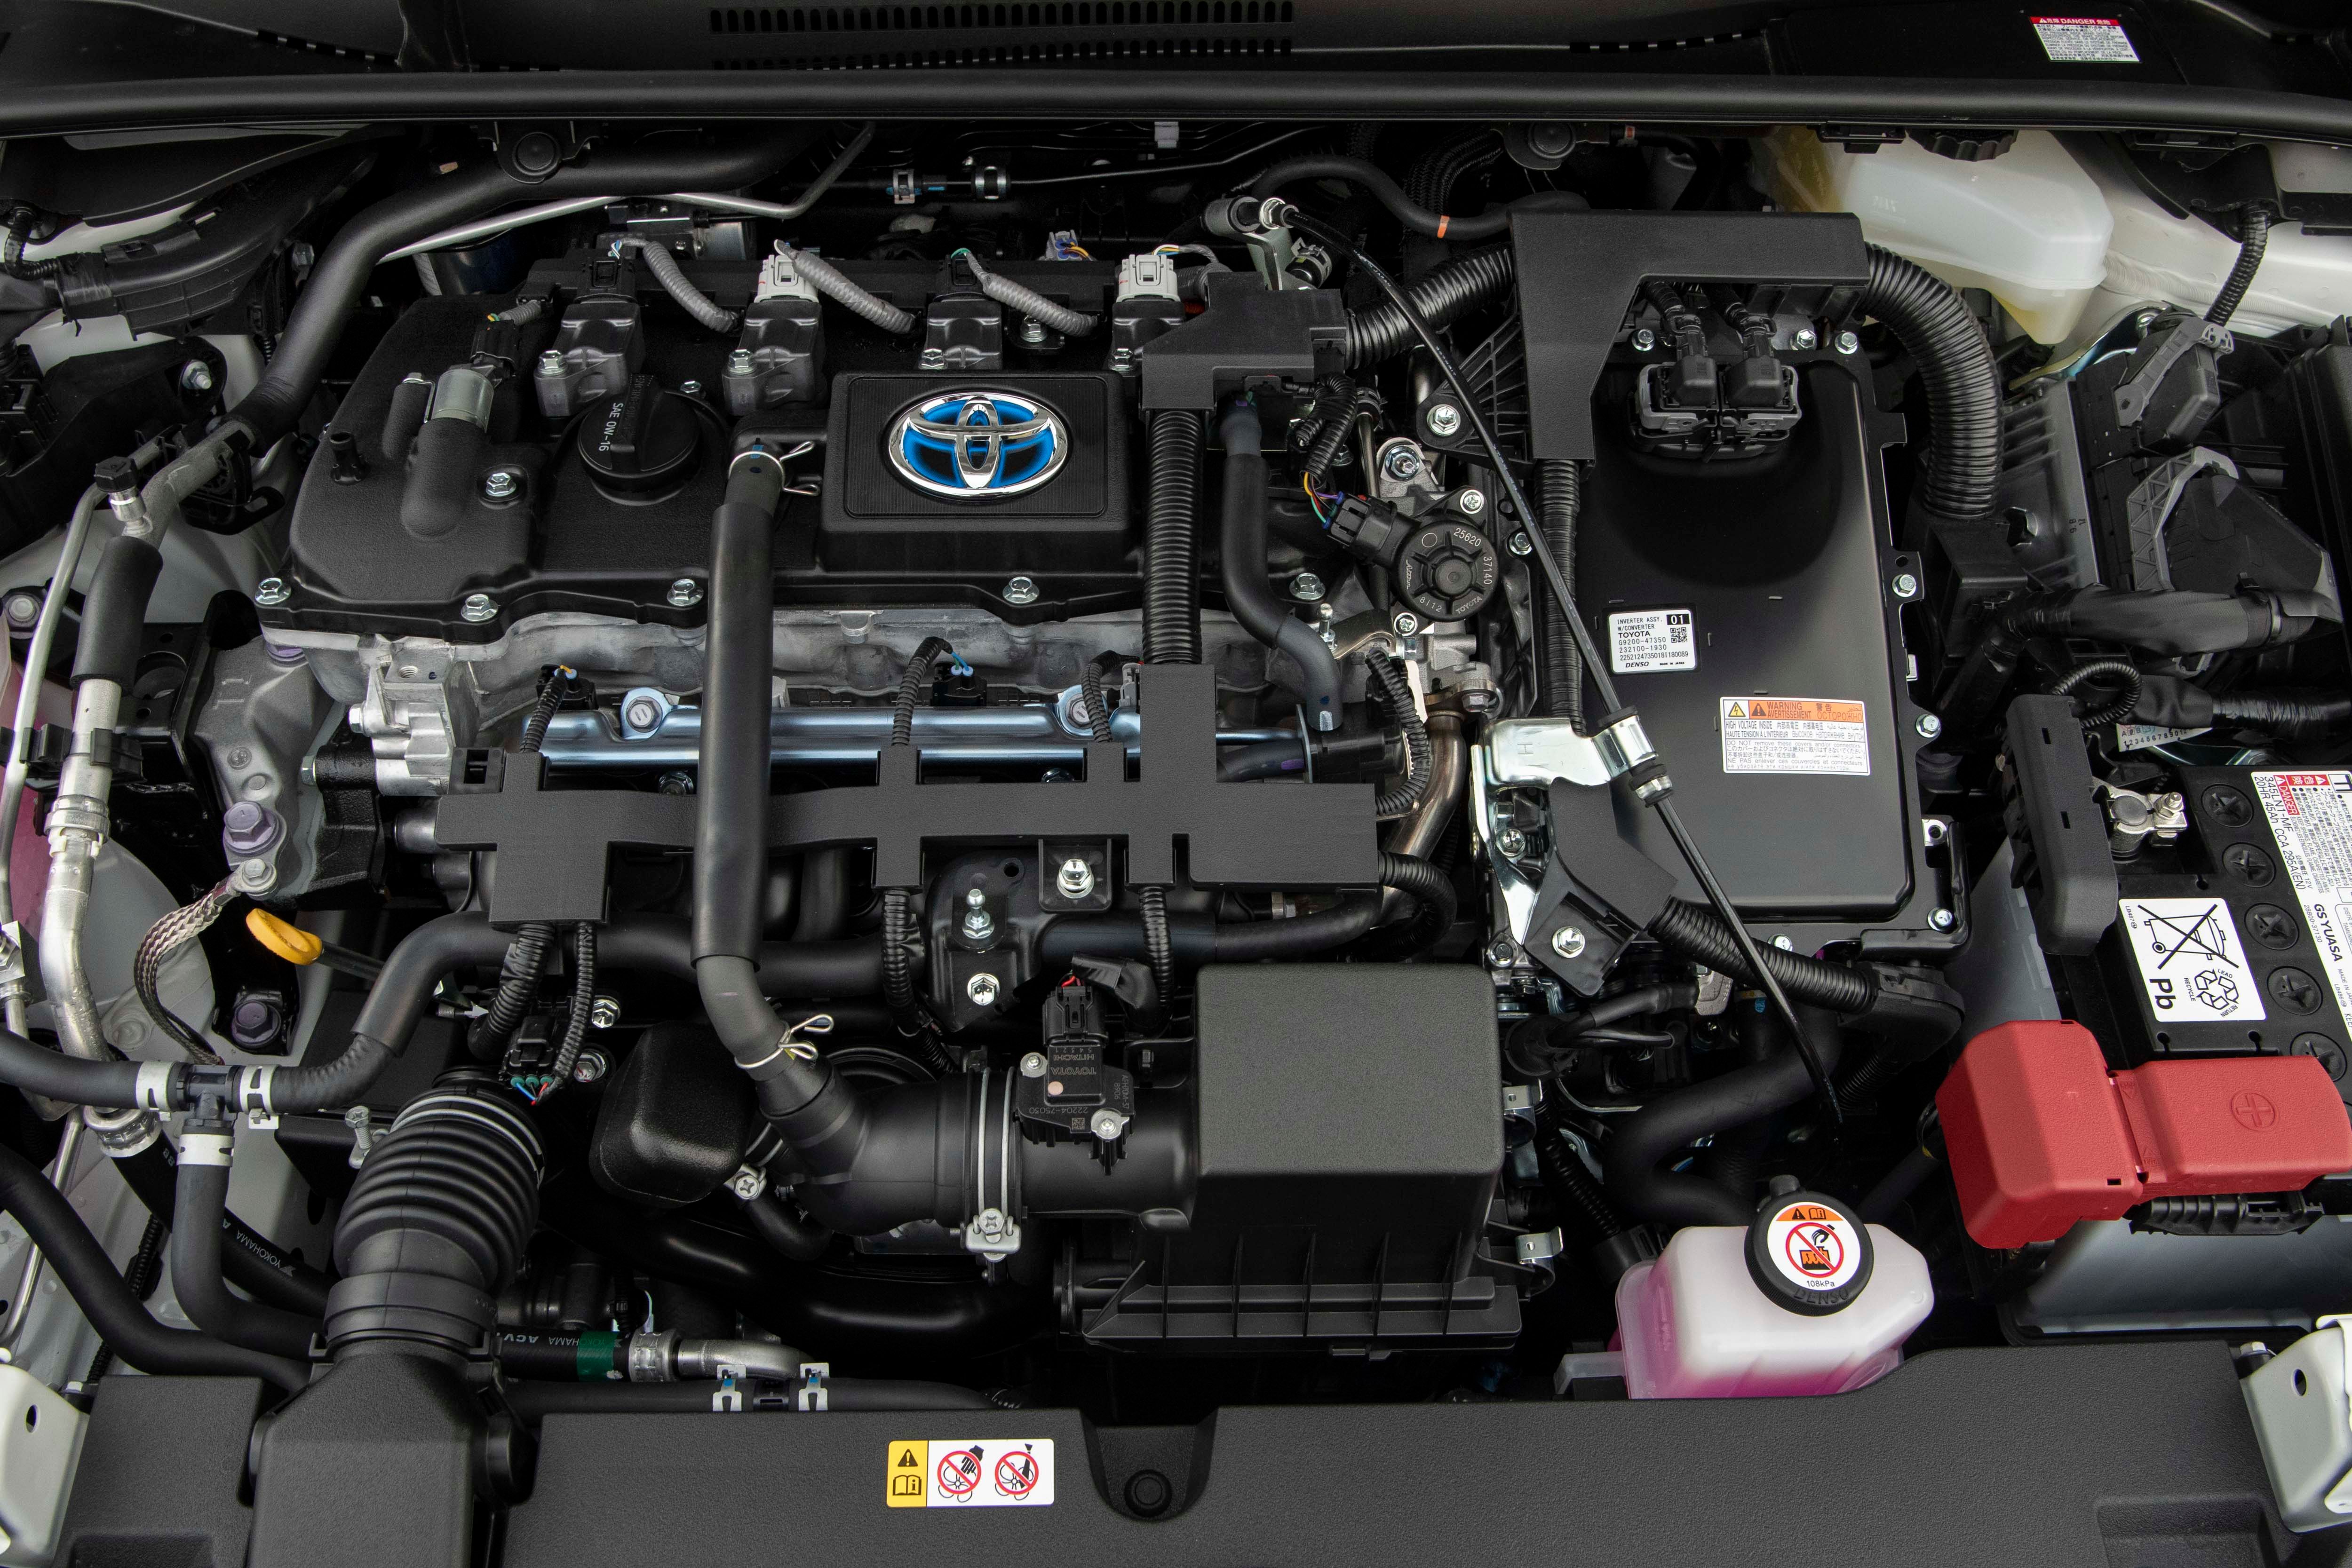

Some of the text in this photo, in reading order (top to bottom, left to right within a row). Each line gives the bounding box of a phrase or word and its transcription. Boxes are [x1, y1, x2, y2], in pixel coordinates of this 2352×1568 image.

[598, 403, 624, 451] SAE 0W-16
[1453, 528, 1481, 547] 25620
[1483, 556, 1493, 585] 37140
[1455, 595, 1483, 615] TOYOTA
[1671, 615, 1683, 625] 01
[1619, 637, 1666, 646] G9200-47350
[1619, 644, 1667, 653] 232100-1930
[1767, 701, 1832, 712] WARNING 警告
[1768, 709, 1862, 722] AVERTISSEMENT ОСТОРОЖНО
[1726, 721, 1736, 729] HIGH
[1738, 721, 1757, 729] VOLTAGE
[2291, 776, 2314, 784] 危険
[2265, 776, 2294, 832] 345LN1-MF
[2279, 786, 2297, 814] DANGER
[2254, 776, 2306, 889] 20HR 45Ah CCA 295A(EN)
[2296, 816, 2304, 826] KEEP
[2312, 857, 2326, 880] CIGARETTES
[2296, 855, 2313, 889] 公称電圧 12V
[2125, 905, 2135, 923] LB487
[2304, 905, 2322, 942] 28800-37130
[2217, 968, 2233, 978] LEAD
[2338, 969, 2347, 983] MADE
[2149, 979, 2176, 1009] Pb
[2184, 978, 2196, 1001] RECYCLE
[2334, 984, 2344, 1000] LB486
[2220, 1004, 2238, 1017] RETURN
[1050, 1066, 1097, 1076] TOYOTA
[237, 1230, 282, 1269] YOKOHAMA
[1806, 1279, 1836, 1289] 108kPa
[1794, 1287, 1850, 1305] DENSO
[548, 1337, 605, 1346] YOKOHAMA
